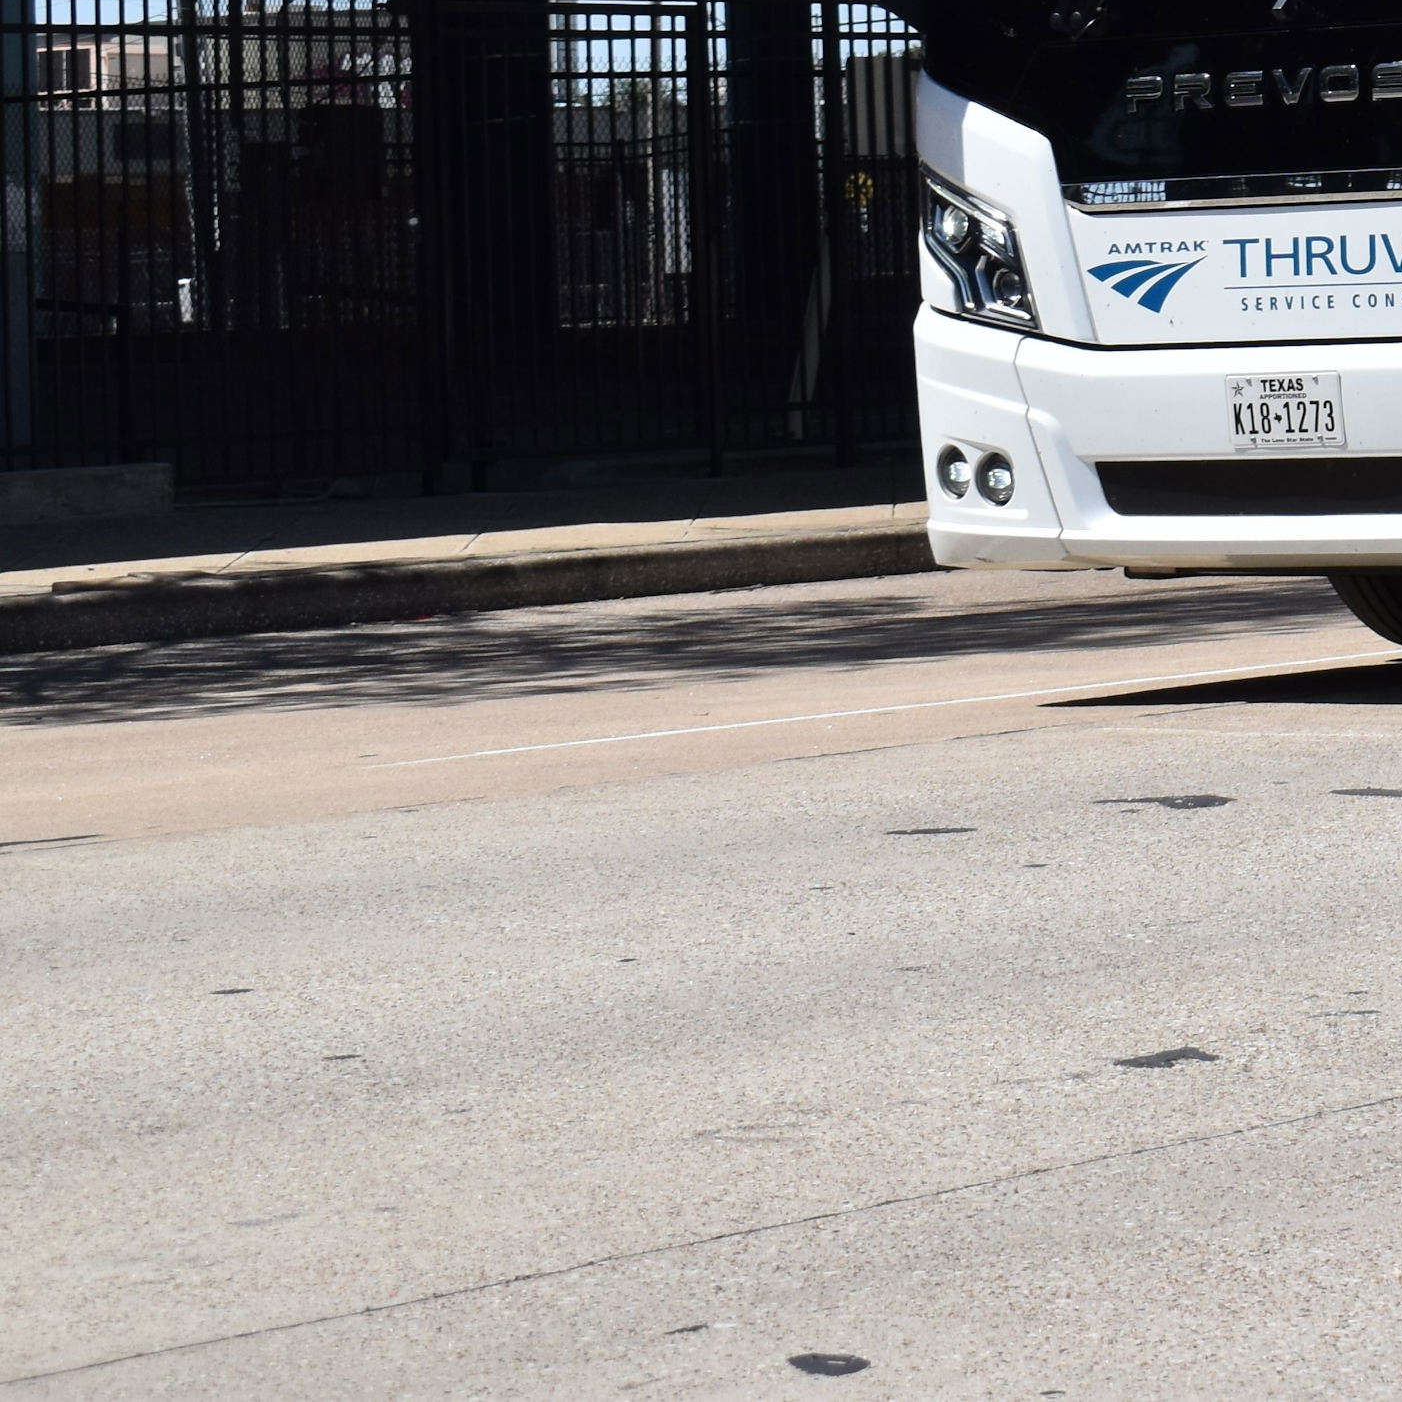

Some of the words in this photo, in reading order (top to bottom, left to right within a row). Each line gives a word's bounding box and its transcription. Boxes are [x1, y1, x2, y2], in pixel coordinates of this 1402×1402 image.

[1107, 239, 1206, 255] AMTRAK
[1241, 294, 1335, 312] SERVICE
[1260, 378, 1304, 393] TEXAS
